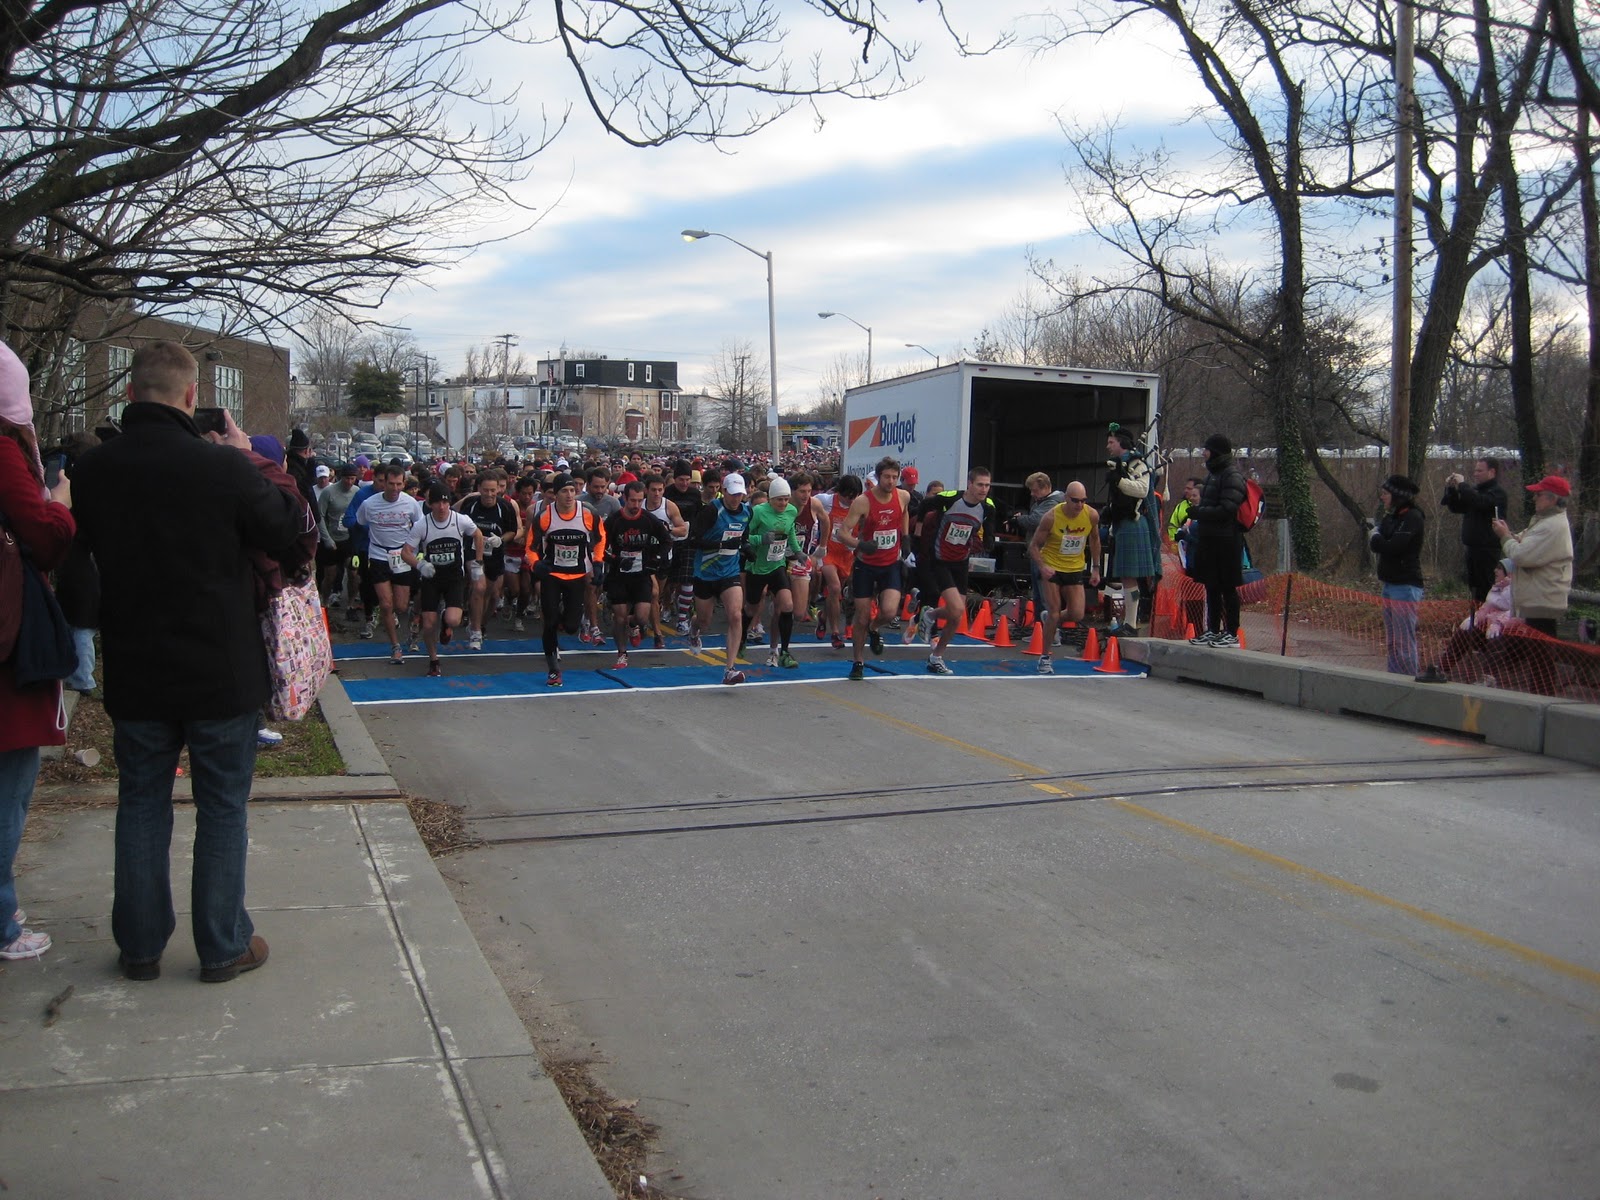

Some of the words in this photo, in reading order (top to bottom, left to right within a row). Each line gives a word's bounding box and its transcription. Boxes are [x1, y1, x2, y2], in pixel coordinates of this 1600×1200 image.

[880, 412, 916, 453] Budget
[847, 464, 866, 479] Moving
[949, 527, 971, 539] 1204
[875, 535, 896, 546] 1384
[1064, 540, 1081, 548] 230
[431, 553, 454, 563] 1231
[556, 550, 578, 559] 1432
